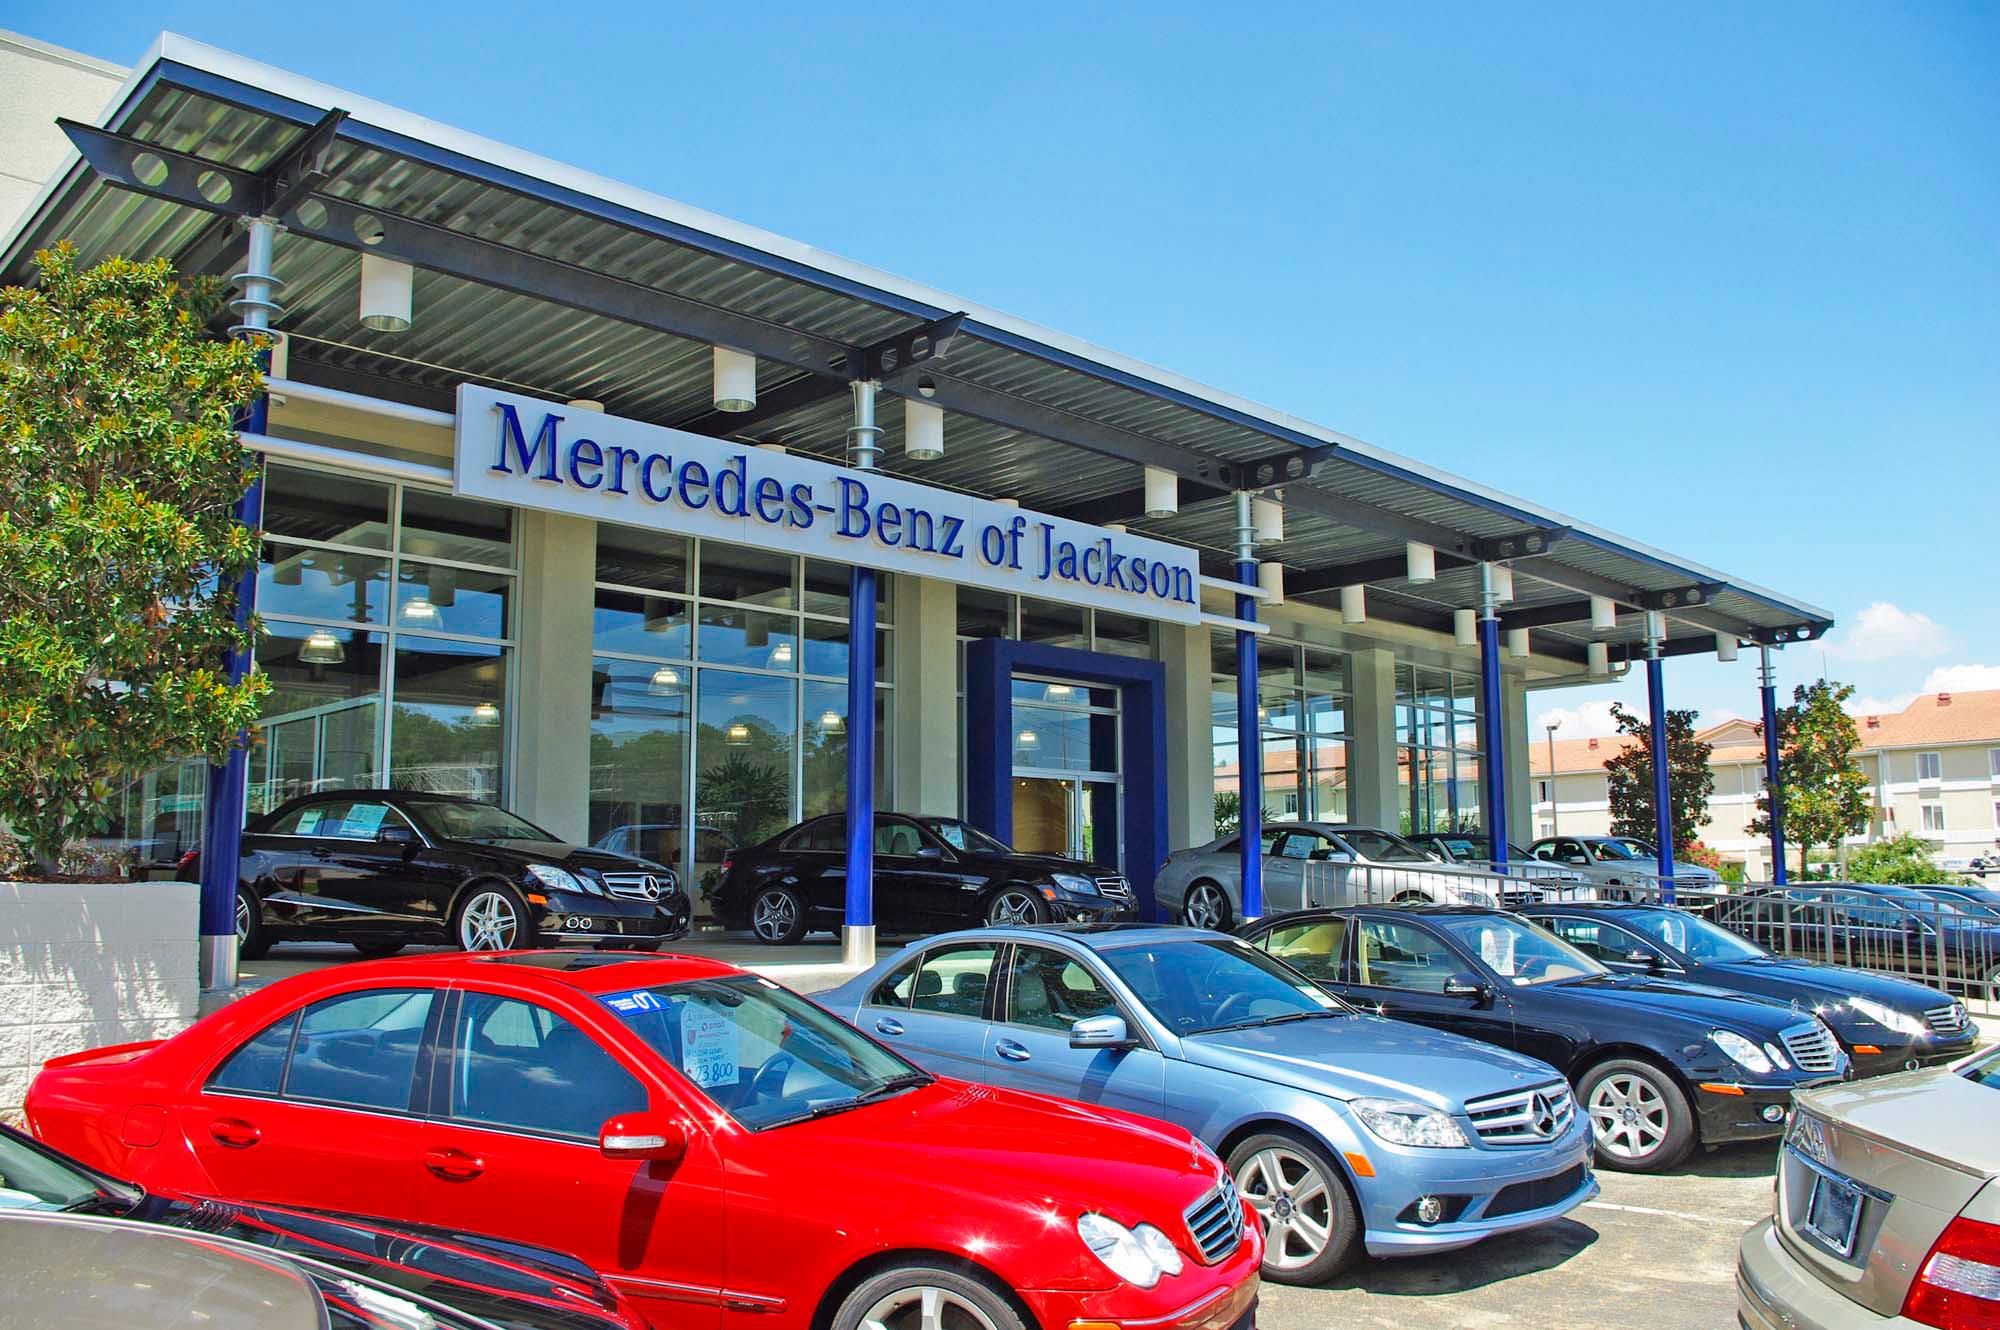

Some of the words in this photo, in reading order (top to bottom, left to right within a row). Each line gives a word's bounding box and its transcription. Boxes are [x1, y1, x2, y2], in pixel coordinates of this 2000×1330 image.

[490, 401, 965, 559] Mercedes-Benz
[977, 515, 1027, 569] of
[1033, 521, 1196, 604] Jackson
[632, 991, 661, 1010] 07
